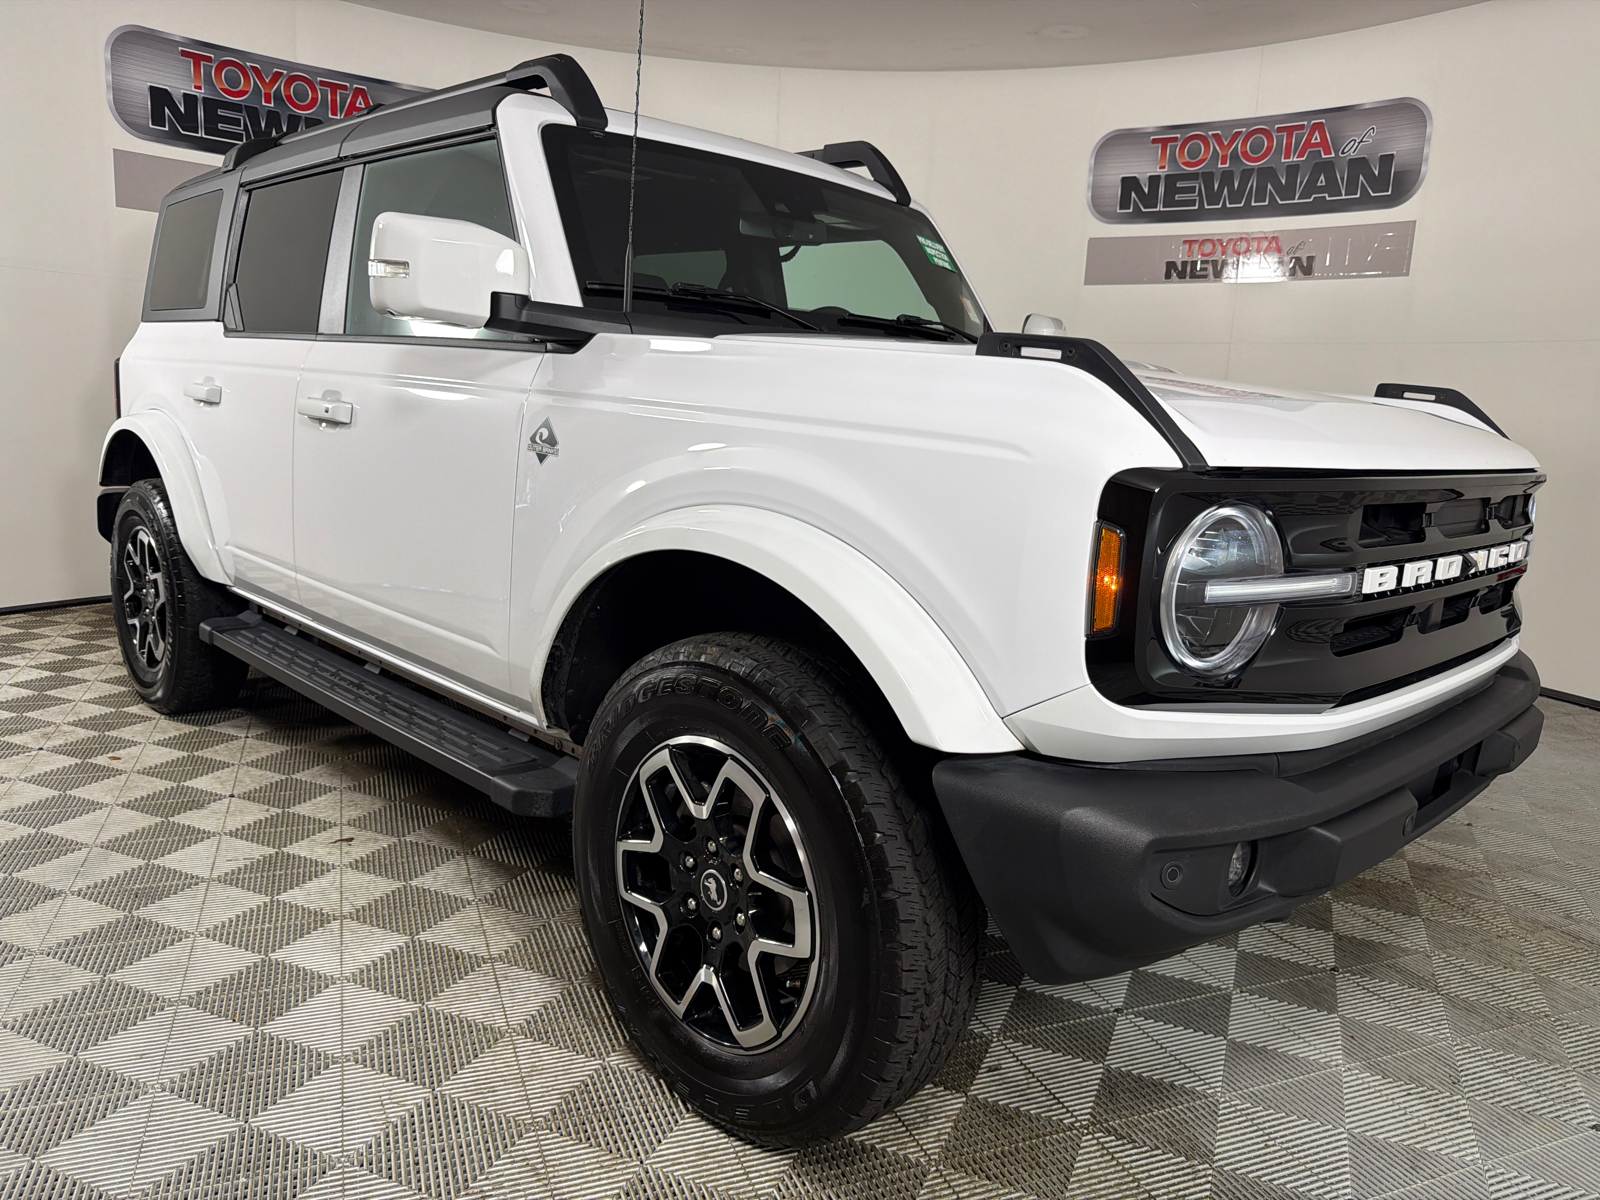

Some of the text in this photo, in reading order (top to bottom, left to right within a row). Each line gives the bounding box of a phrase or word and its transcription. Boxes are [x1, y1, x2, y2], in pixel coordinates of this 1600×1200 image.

[179, 48, 374, 119] TOYOTA
[148, 84, 323, 142] NEW
[1151, 120, 1376, 170] TOYOTA of
[1118, 153, 1395, 211] NEWNAN
[1164, 255, 1315, 280] NEWN
[1182, 236, 1306, 258] TOYOTA of
[587, 674, 792, 775] BRIDGESTONE
